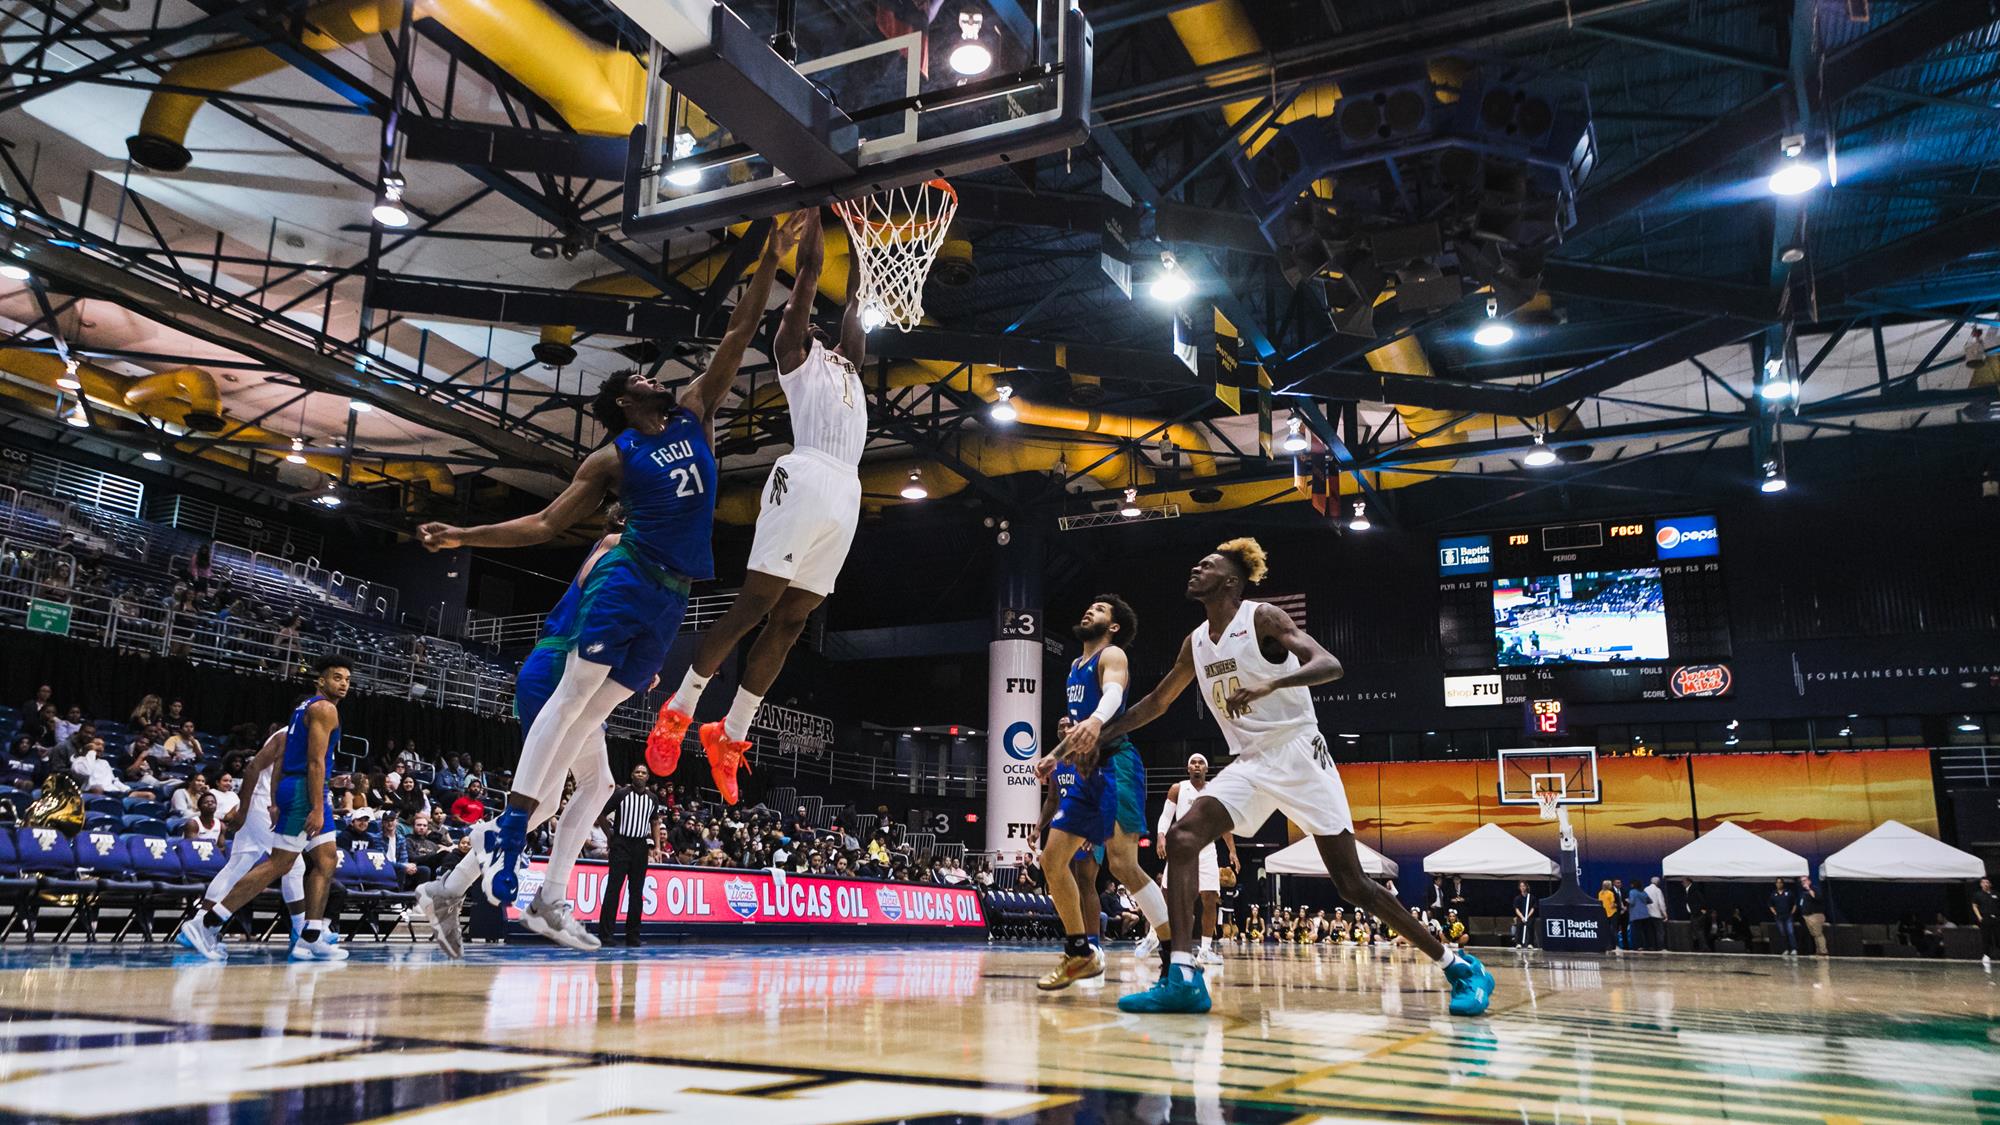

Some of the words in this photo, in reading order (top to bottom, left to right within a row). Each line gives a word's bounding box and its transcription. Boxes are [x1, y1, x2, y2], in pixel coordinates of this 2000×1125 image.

[649, 439, 694, 468] FGCU
[669, 463, 704, 498] 21
[1509, 534, 1529, 545] FIU
[1680, 527, 1719, 543] pepsi
[1461, 545, 1490, 557] Baptist
[1461, 554, 1489, 564] Health
[1553, 553, 1577, 563] PERIOD
[1018, 614, 1035, 635] 3
[1505, 673, 1527, 681] FOULS
[1640, 667, 1662, 675] FOULS
[1678, 668, 1722, 683] Jersey
[1807, 666, 1949, 682] FONTAINEBLEAU
[1006, 678, 1036, 694] FIU
[1066, 684, 1085, 704] FGCU
[1312, 693, 1350, 704] MIAMI
[1357, 691, 1397, 701] BEACH
[1505, 696, 1527, 705] SCORE
[1642, 690, 1666, 699] SCORE
[1534, 701, 1561, 714] 5:30
[1540, 713, 1557, 732] 12
[1007, 776, 1036, 786] BANK
[1057, 774, 1075, 785] FGCU
[935, 813, 950, 834] 3
[666, 877, 710, 915] OIL
[762, 882, 832, 918] LUCAS
[836, 886, 869, 918] OIL
[903, 890, 954, 921] LUCAS
[956, 894, 981, 922] OIL
[1567, 919, 1598, 930] Baptist
[1568, 929, 1598, 938] Health
